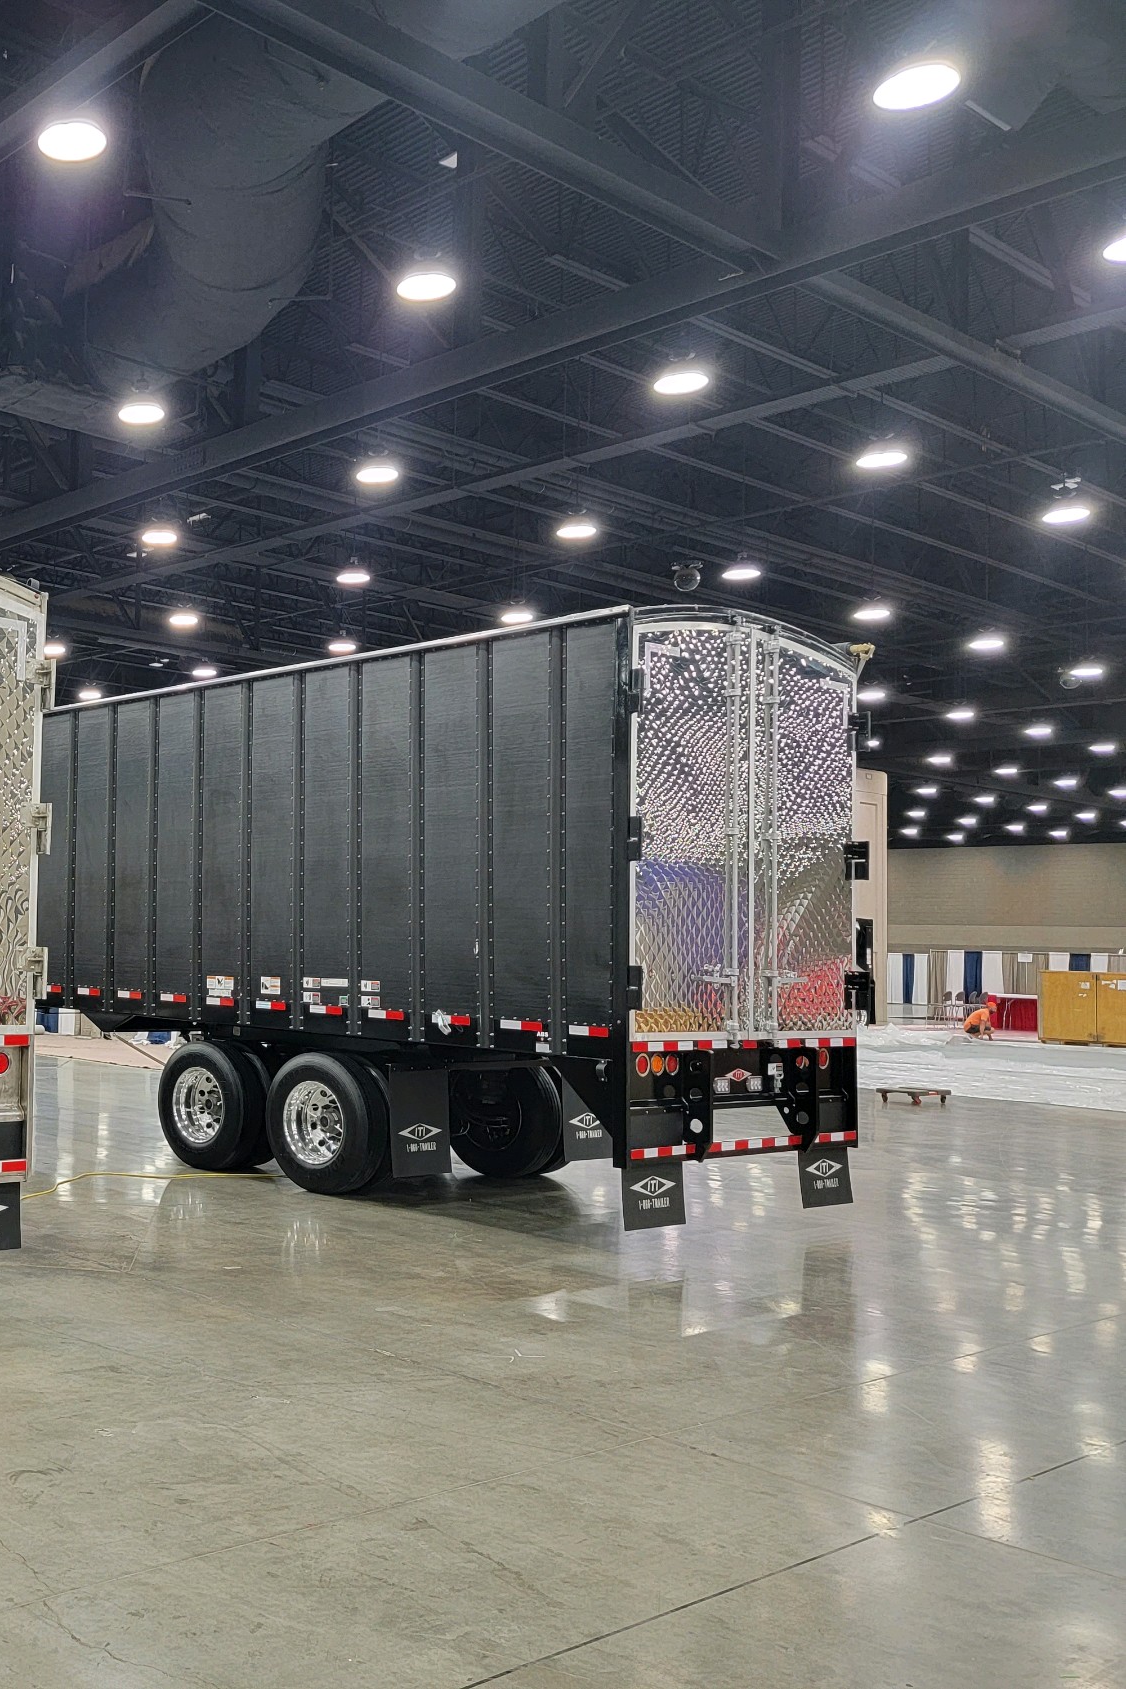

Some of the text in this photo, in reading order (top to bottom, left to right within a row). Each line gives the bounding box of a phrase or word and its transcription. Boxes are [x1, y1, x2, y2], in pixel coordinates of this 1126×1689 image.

[584, 1115, 593, 1125] ITI
[415, 1126, 426, 1137] ITI
[819, 1162, 829, 1174] ITI
[647, 1179, 659, 1191] ITI
